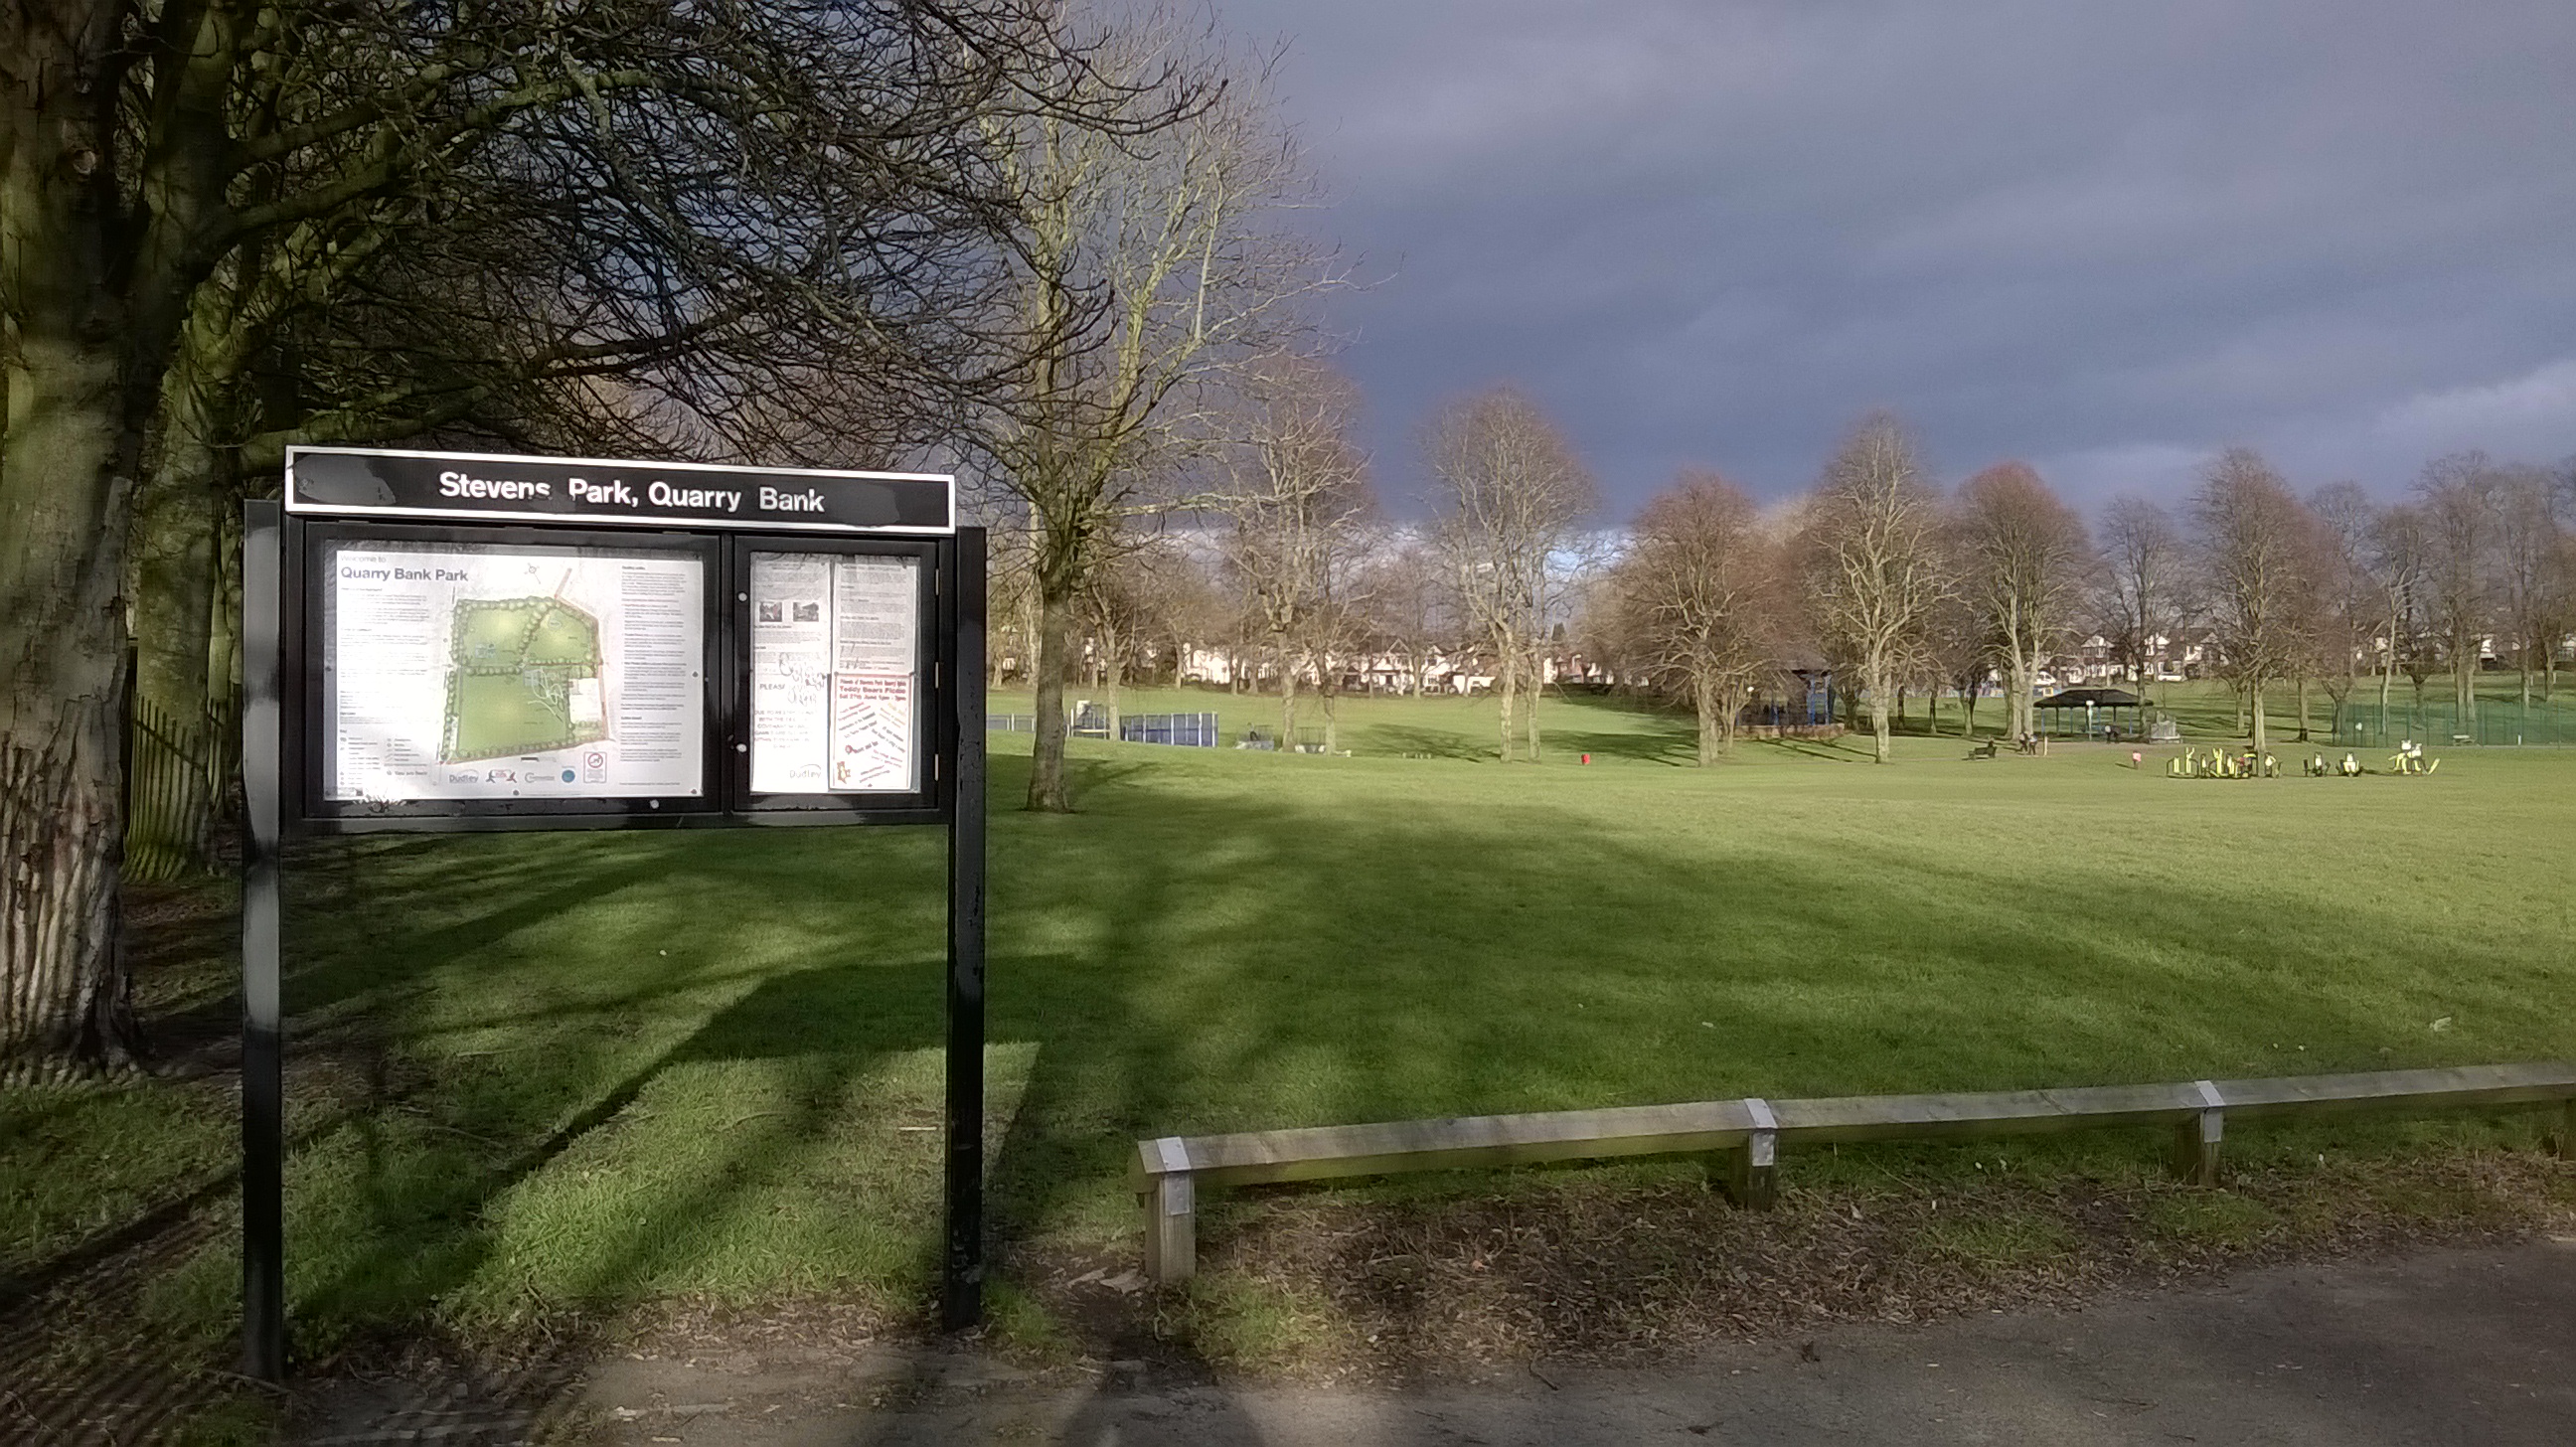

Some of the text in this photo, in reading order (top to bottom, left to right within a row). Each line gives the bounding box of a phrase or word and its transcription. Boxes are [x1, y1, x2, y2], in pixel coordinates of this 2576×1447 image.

[439, 471, 826, 513] Stevens Park, Quarry Bank
[341, 566, 468, 582] Quarry Bank Park
[449, 773, 479, 784] Dudley
